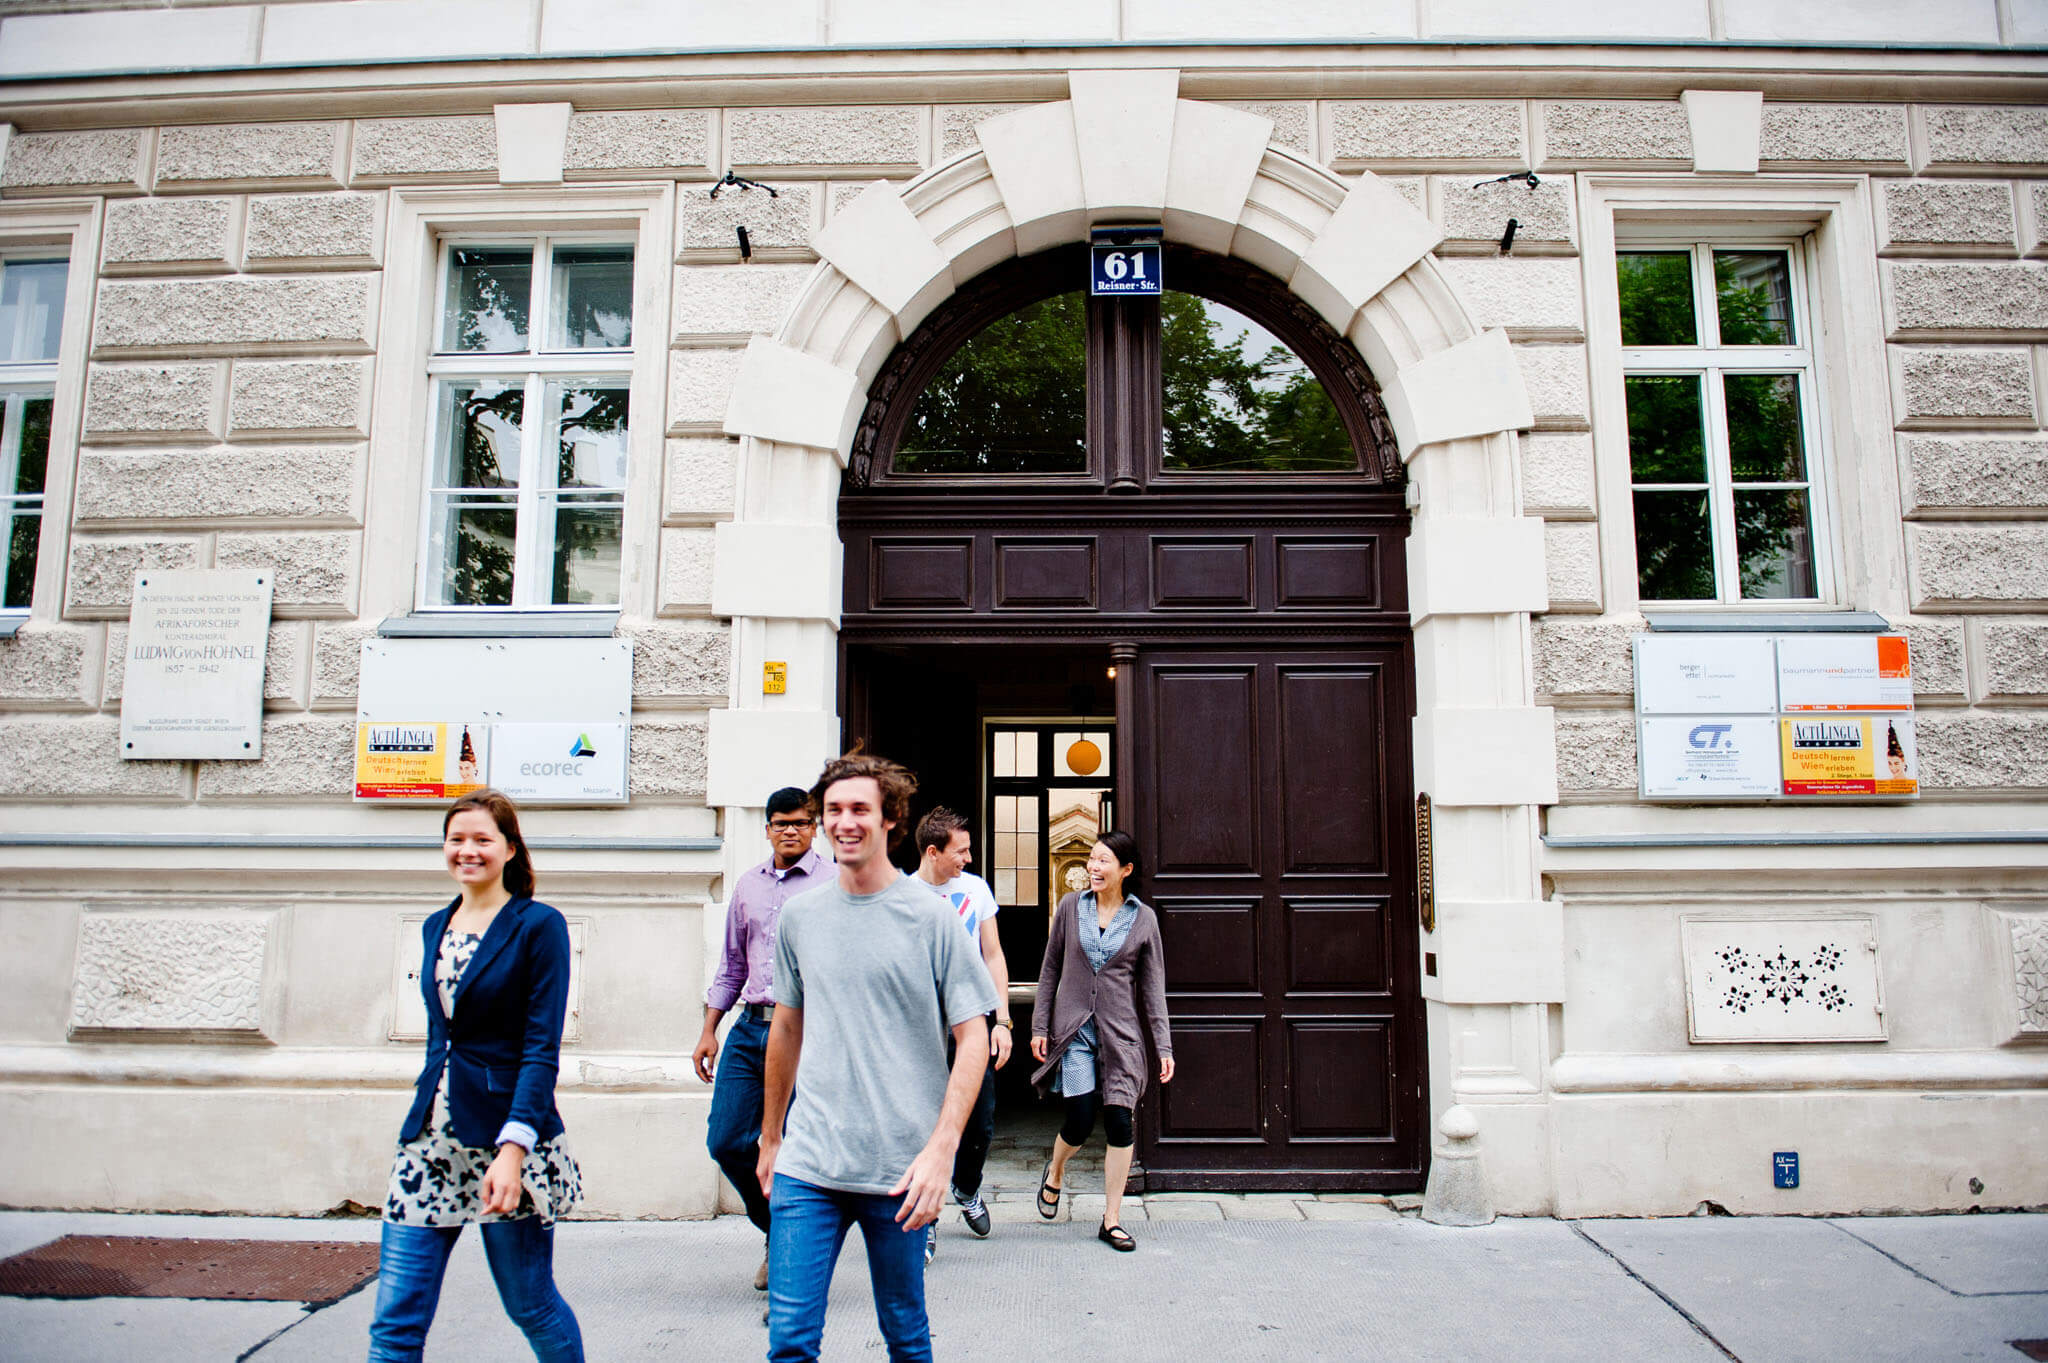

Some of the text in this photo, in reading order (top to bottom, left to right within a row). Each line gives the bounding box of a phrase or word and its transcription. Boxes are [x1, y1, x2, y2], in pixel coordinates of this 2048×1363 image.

[1104, 251, 1146, 280] 61
[154, 619, 240, 629] AFRIKAFORSCHER
[134, 645, 184, 660] LUDWIG
[164, 664, 185, 673] 1857
[198, 664, 220, 673] 1942
[366, 755, 402, 764] Deutsch
[1792, 751, 1829, 760] Deutsch
[373, 766, 396, 774] Wien
[520, 761, 584, 777] ecorec
[1800, 761, 1855, 772] Wien erleben
[1776, 1156, 1785, 1164] AX
